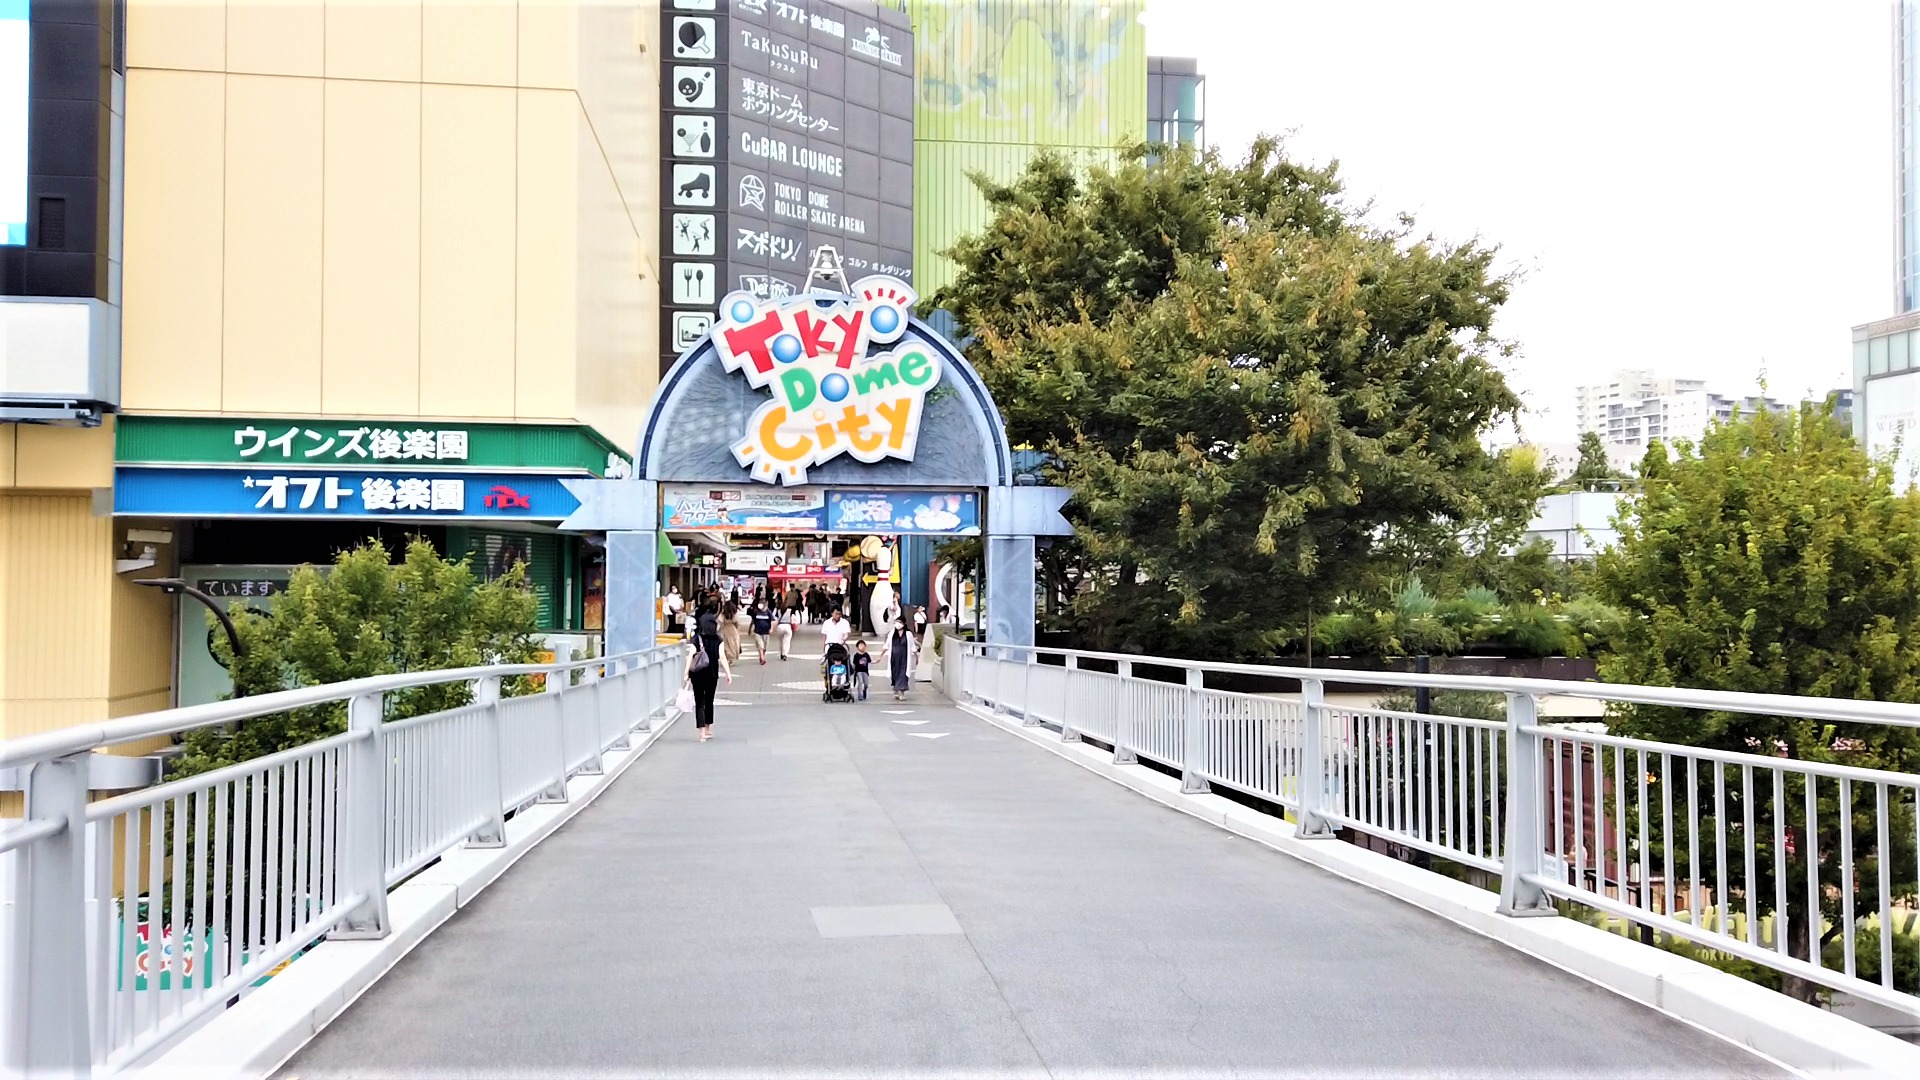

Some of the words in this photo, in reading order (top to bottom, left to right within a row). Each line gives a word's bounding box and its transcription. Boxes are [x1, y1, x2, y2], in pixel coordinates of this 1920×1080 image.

[741, 77, 804, 110] 東京ドーム
[741, 96, 840, 132] ボウリングセンター
[792, 145, 843, 177] LOUNGE
[774, 182, 802, 202] TOKYO
[808, 190, 829, 210] DOME
[774, 200, 808, 221] ROLLER
[811, 208, 837, 228] SKATE
[839, 215, 866, 235] ARENA
[780, 351, 933, 412] Dome
[234, 426, 469, 460] ウインズ後楽園
[759, 398, 912, 462] City
[361, 477, 464, 511] 後楽園
[204, 580, 274, 596] ています
